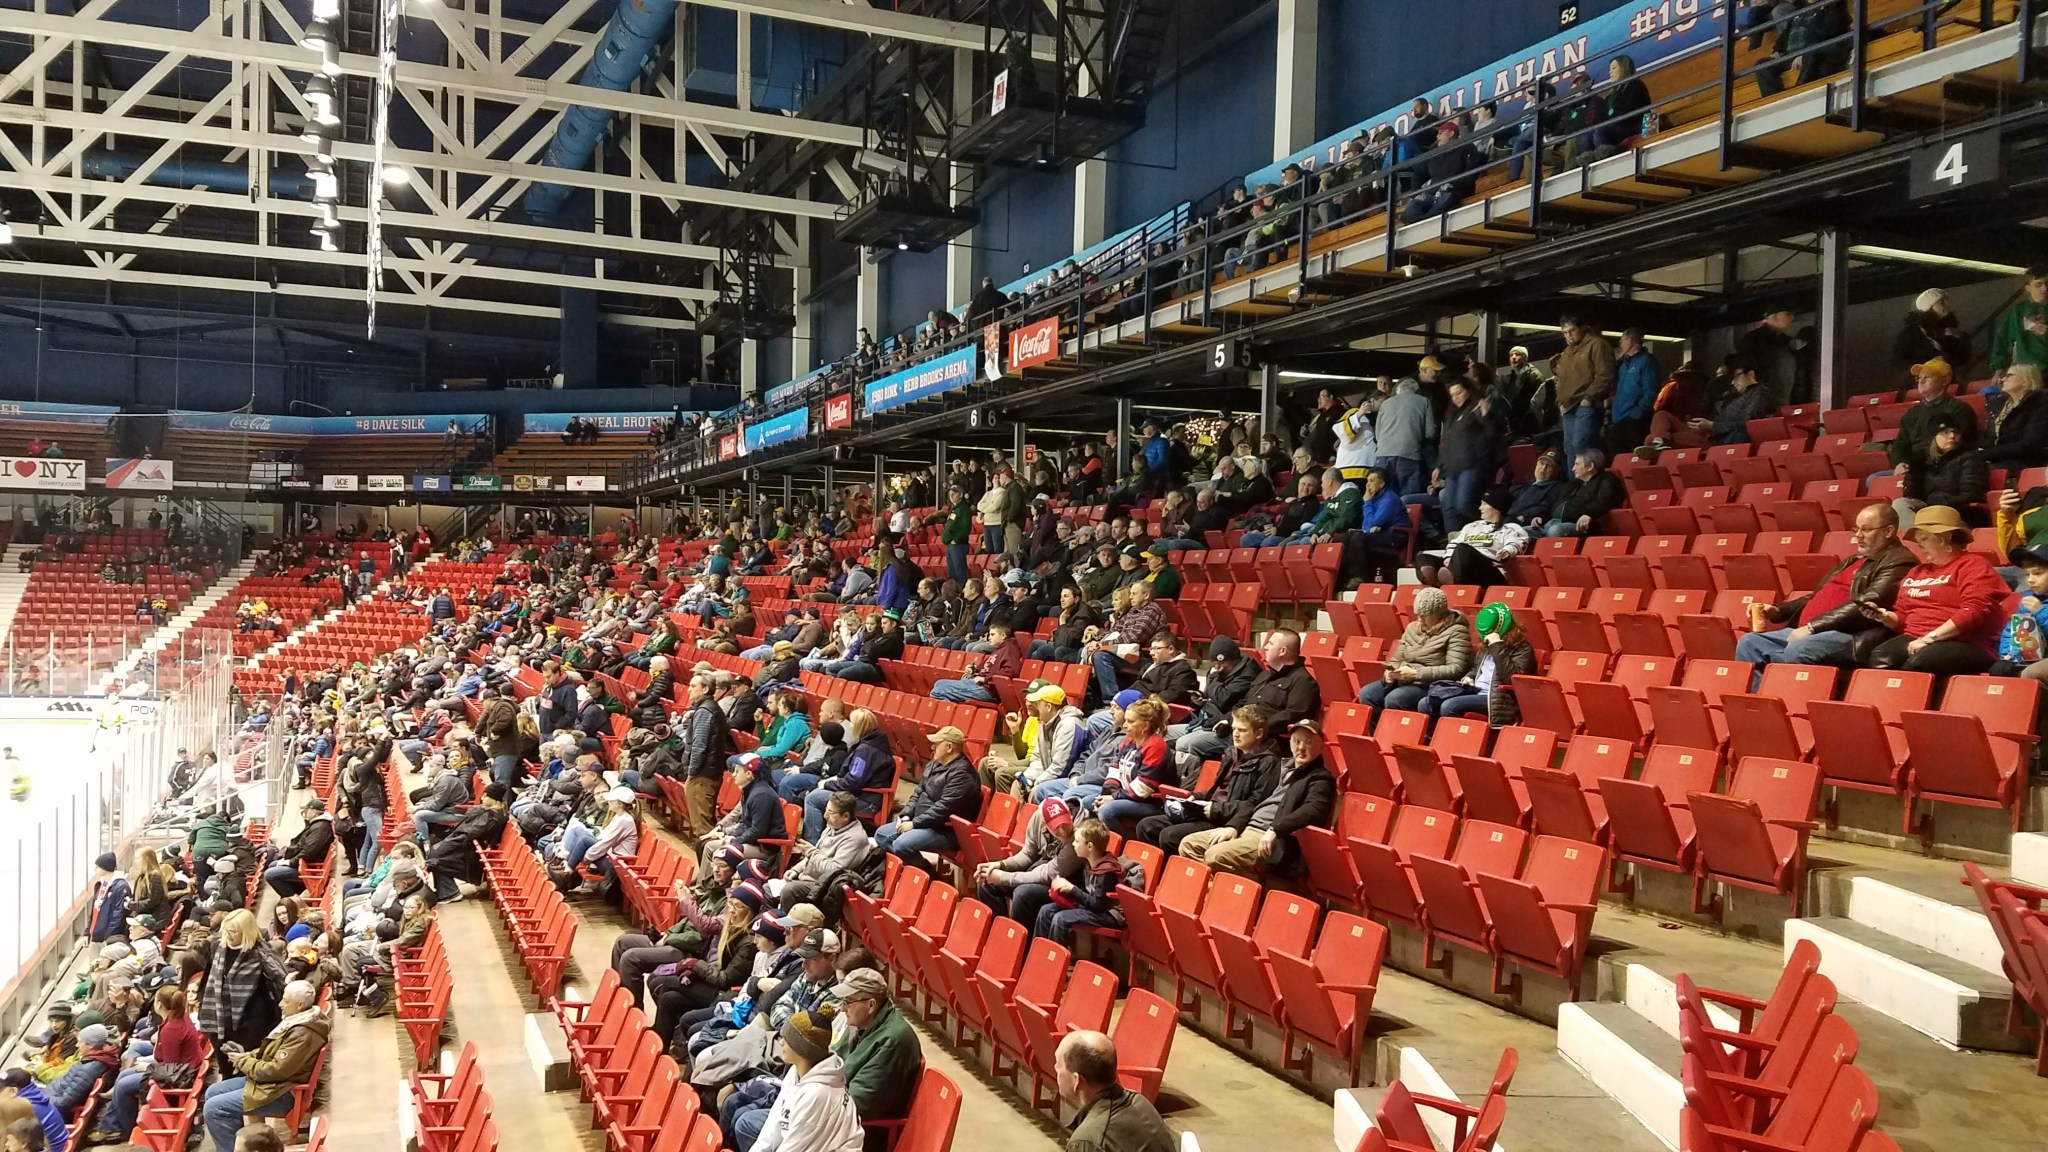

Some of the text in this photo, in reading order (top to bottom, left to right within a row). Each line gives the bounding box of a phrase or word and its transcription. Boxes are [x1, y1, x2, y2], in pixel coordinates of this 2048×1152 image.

[1560, 6, 1577, 25] 52
[1933, 142, 1968, 185] 4
[1214, 343, 1225, 368] 5
[1242, 344, 1251, 367] 5
[904, 376, 919, 393] HERB
[919, 369, 944, 388] BROOKS
[944, 359, 967, 380] ARENA
[355, 418, 426, 430] #8 DAVE SILK
[590, 416, 620, 428] NEAL
[970, 409, 978, 427] 6
[988, 410, 997, 427] 6
[847, 446, 855, 459] 7
[1, 460, 83, 479] I NY
[753, 470, 760, 480] 8
[157, 494, 168, 503] 12
[689, 485, 696, 495] 9
[642, 496, 651, 504] 10
